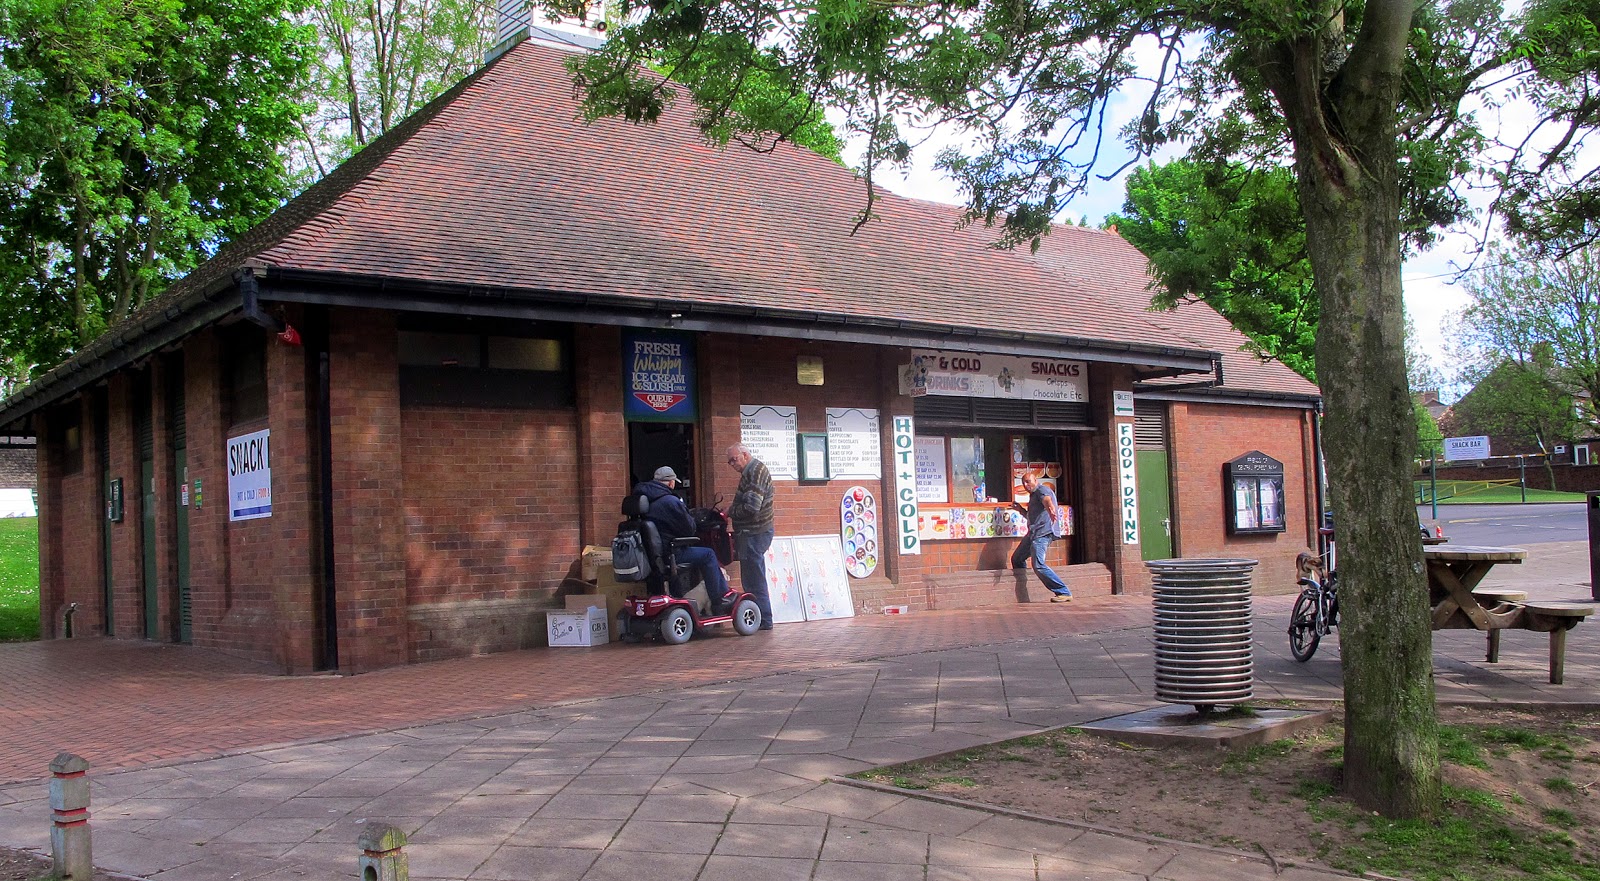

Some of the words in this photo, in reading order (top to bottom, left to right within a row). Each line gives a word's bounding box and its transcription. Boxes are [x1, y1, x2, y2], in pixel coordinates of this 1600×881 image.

[634, 341, 681, 356] FRESH
[633, 354, 682, 376] Whippy
[939, 356, 948, 370] &
[951, 358, 981, 372] COLD
[1031, 361, 1080, 377] SNACKS
[632, 372, 649, 382] ICE
[650, 373, 685, 384] CREAM
[1047, 378, 1068, 388] Crisps
[643, 382, 674, 392] SLUSH
[1033, 389, 1067, 399] Chocolate
[1070, 391, 1082, 399] Etc
[647, 394, 673, 403] QUEUE
[896, 418, 912, 464] HOT
[1120, 425, 1132, 468] FOOD
[230, 438, 264, 477] SNACK
[900, 488, 917, 549] COLD
[1123, 487, 1136, 541] DRINK
